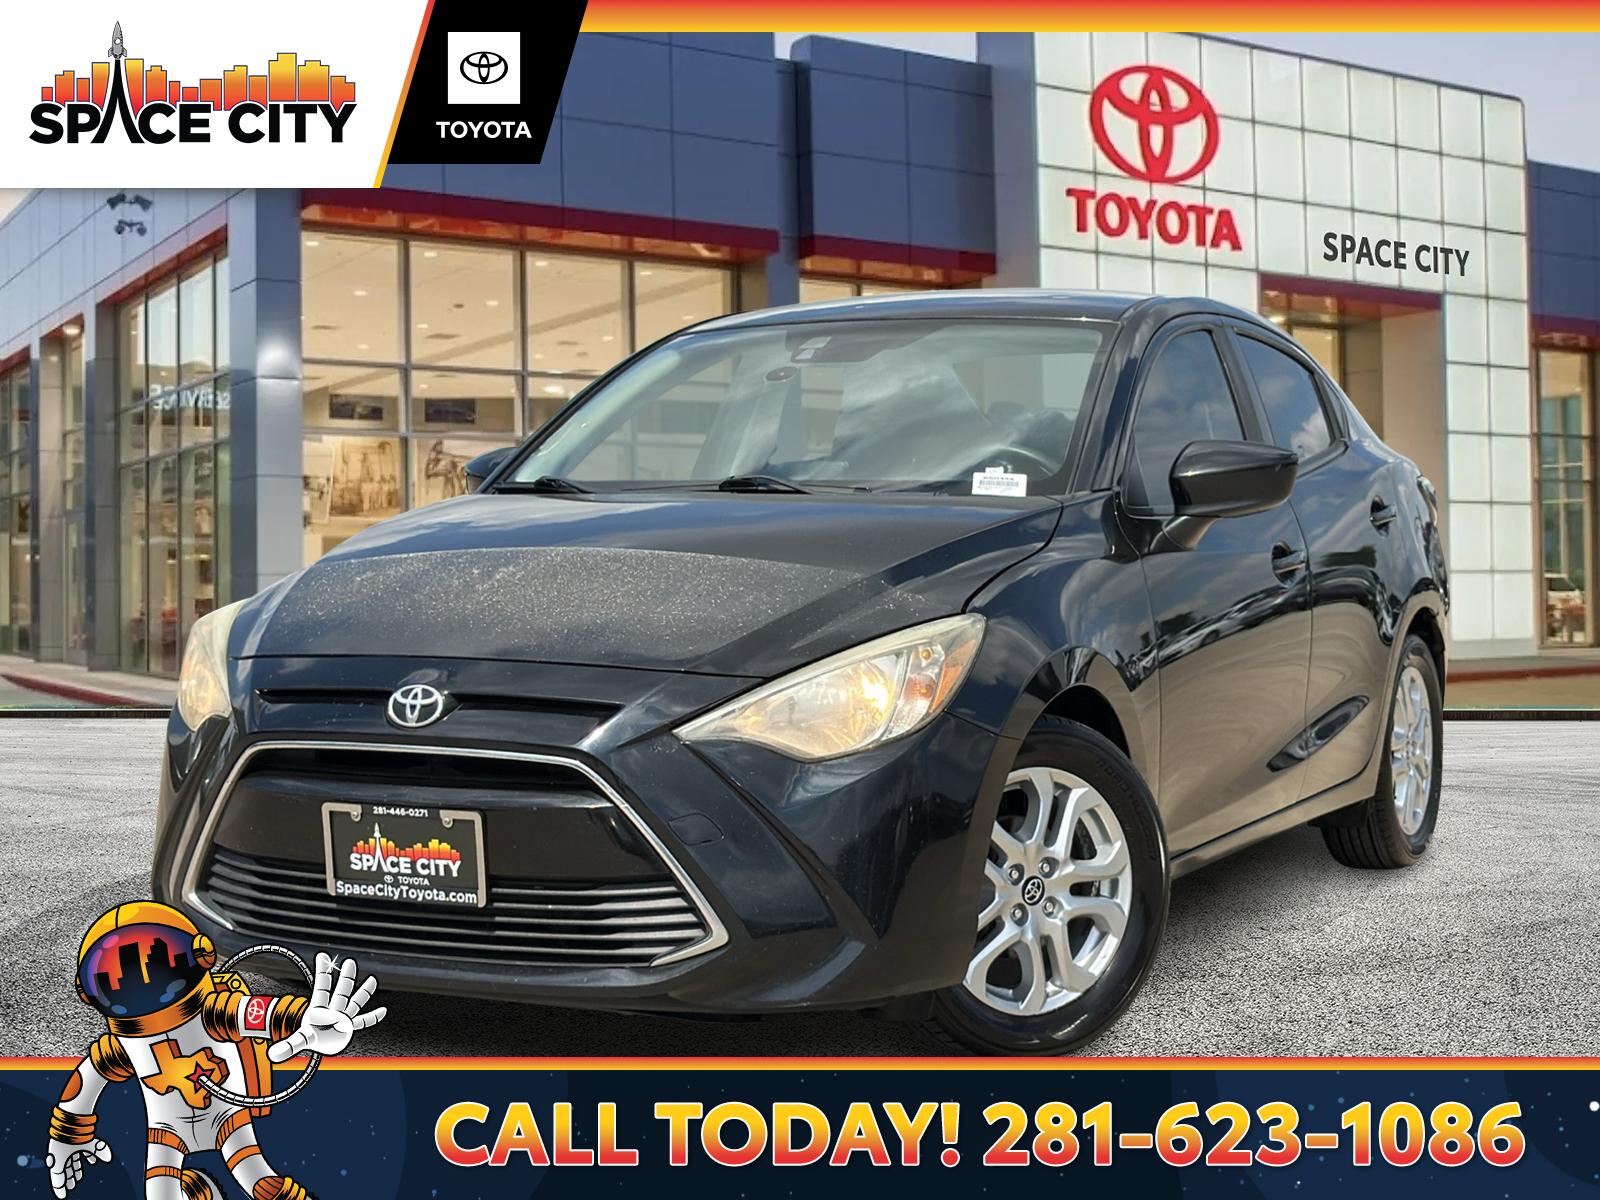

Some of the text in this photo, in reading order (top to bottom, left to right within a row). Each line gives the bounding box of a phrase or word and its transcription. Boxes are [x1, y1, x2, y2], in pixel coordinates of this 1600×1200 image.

[1066, 188, 1242, 251] TOYOTA
[1323, 232, 1470, 276] SPACE CITY
[373, 806, 429, 817] 281-446-0271
[416, 858, 462, 877] CITY
[398, 876, 430, 886] TOYOTA
[336, 880, 478, 904] SpaceCityToyota.com
